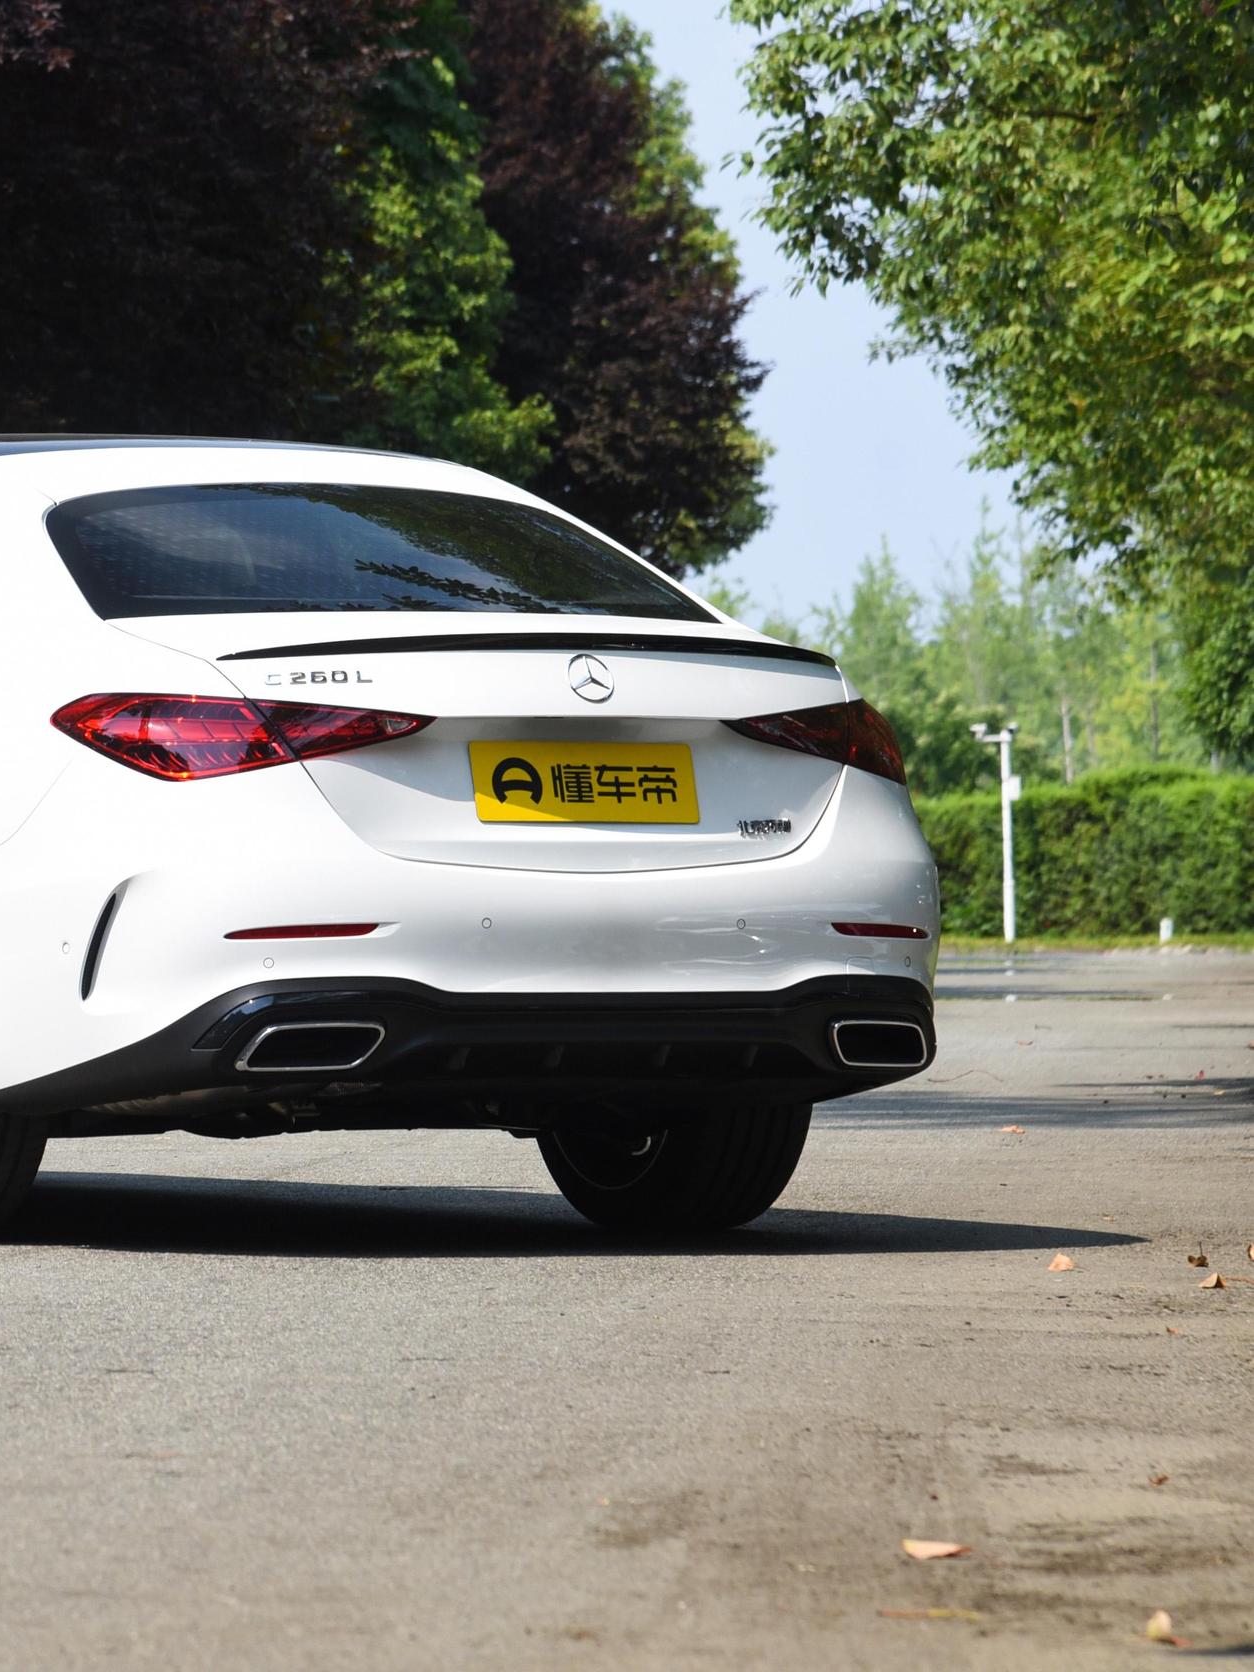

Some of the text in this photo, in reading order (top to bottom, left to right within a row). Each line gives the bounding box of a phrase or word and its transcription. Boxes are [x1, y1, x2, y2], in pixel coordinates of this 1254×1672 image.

[264, 670, 374, 686] C 260 L
[550, 763, 678, 805] 懂车帝
